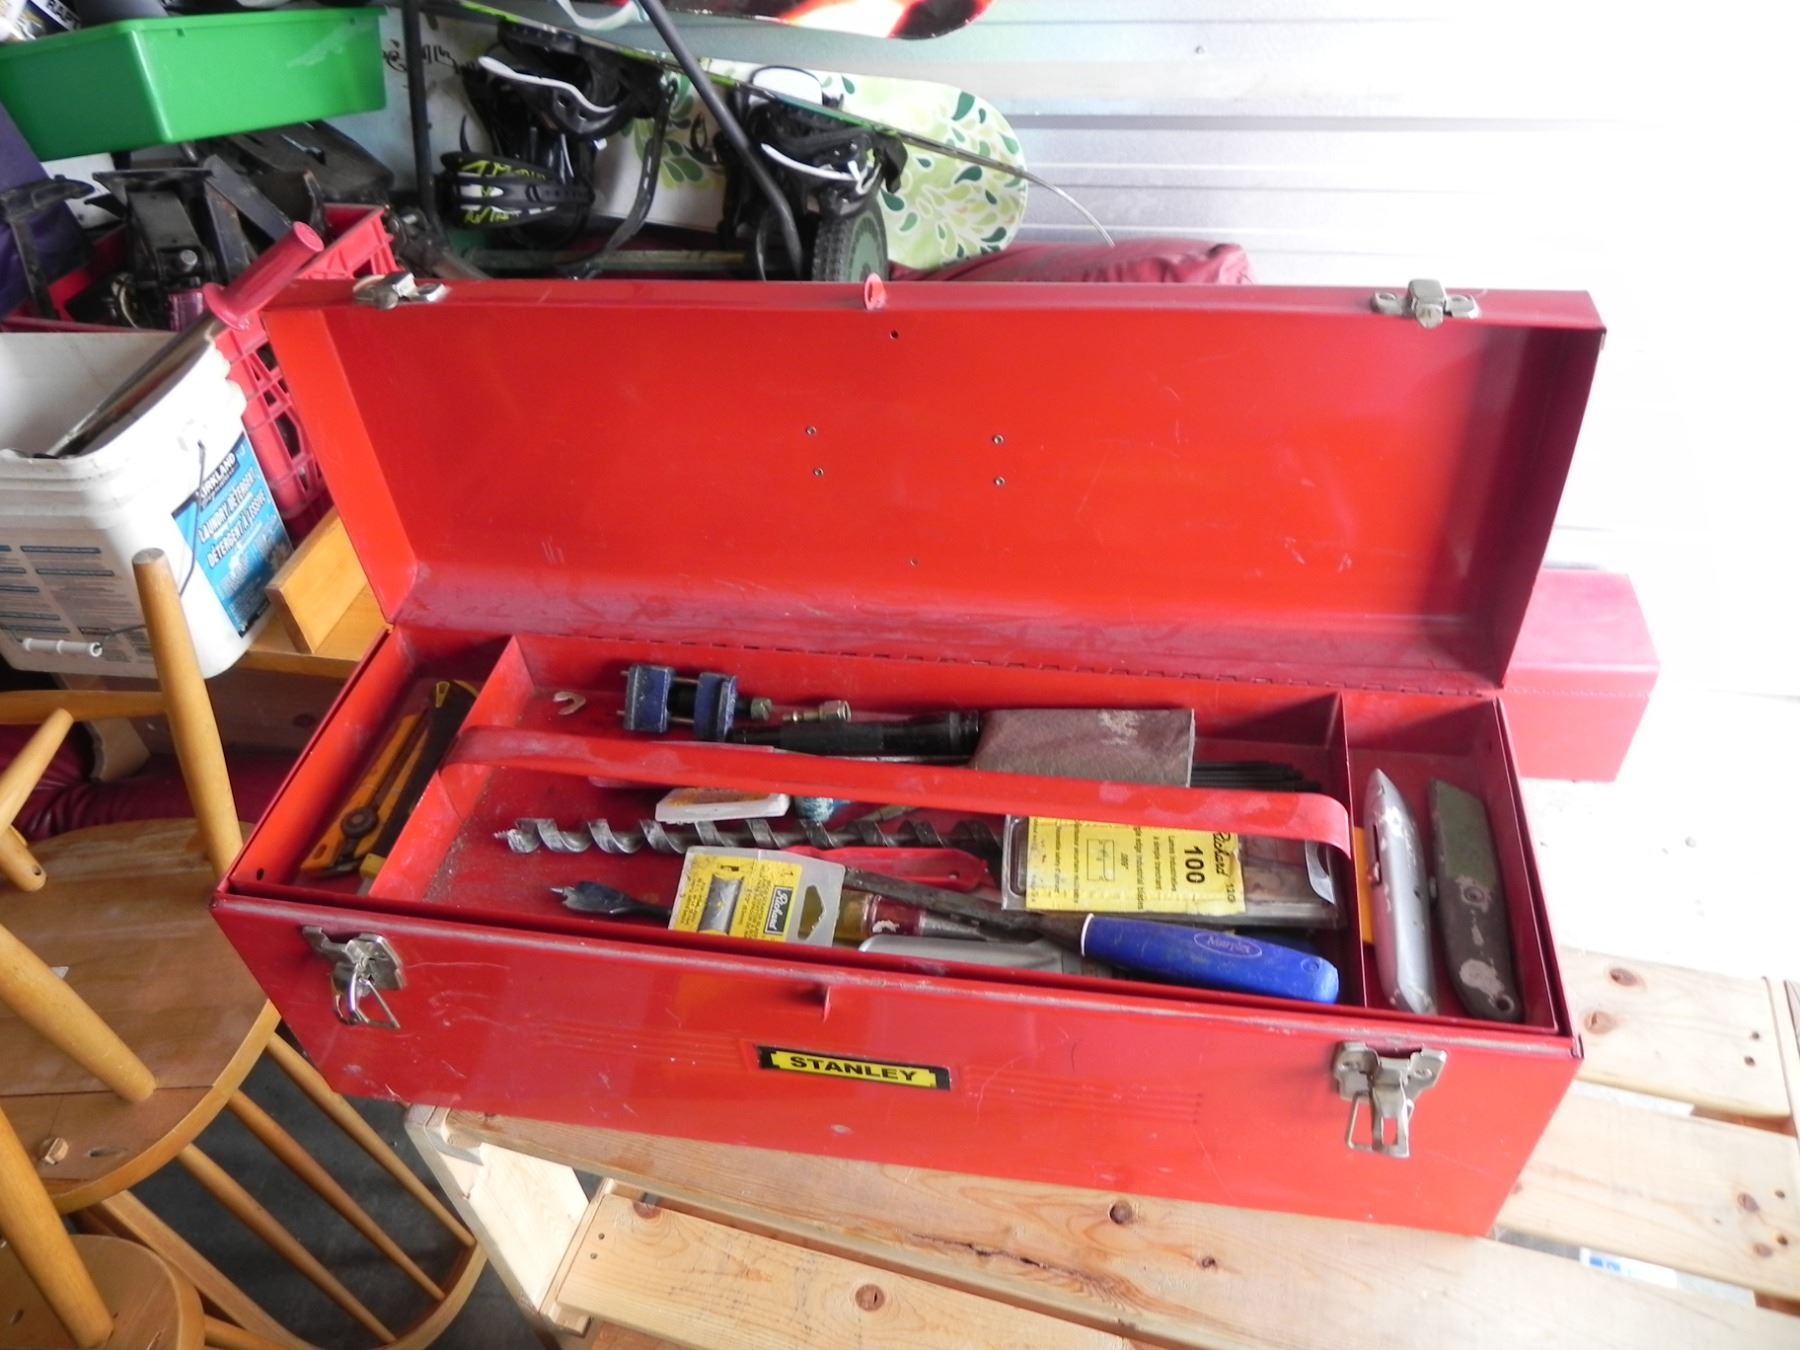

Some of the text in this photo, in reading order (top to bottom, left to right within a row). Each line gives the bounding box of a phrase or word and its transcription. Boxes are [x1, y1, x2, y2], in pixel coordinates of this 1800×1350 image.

[1184, 845, 1205, 884] 100
[769, 889, 788, 930] Richard
[790, 1056, 916, 1081] STANLEY
